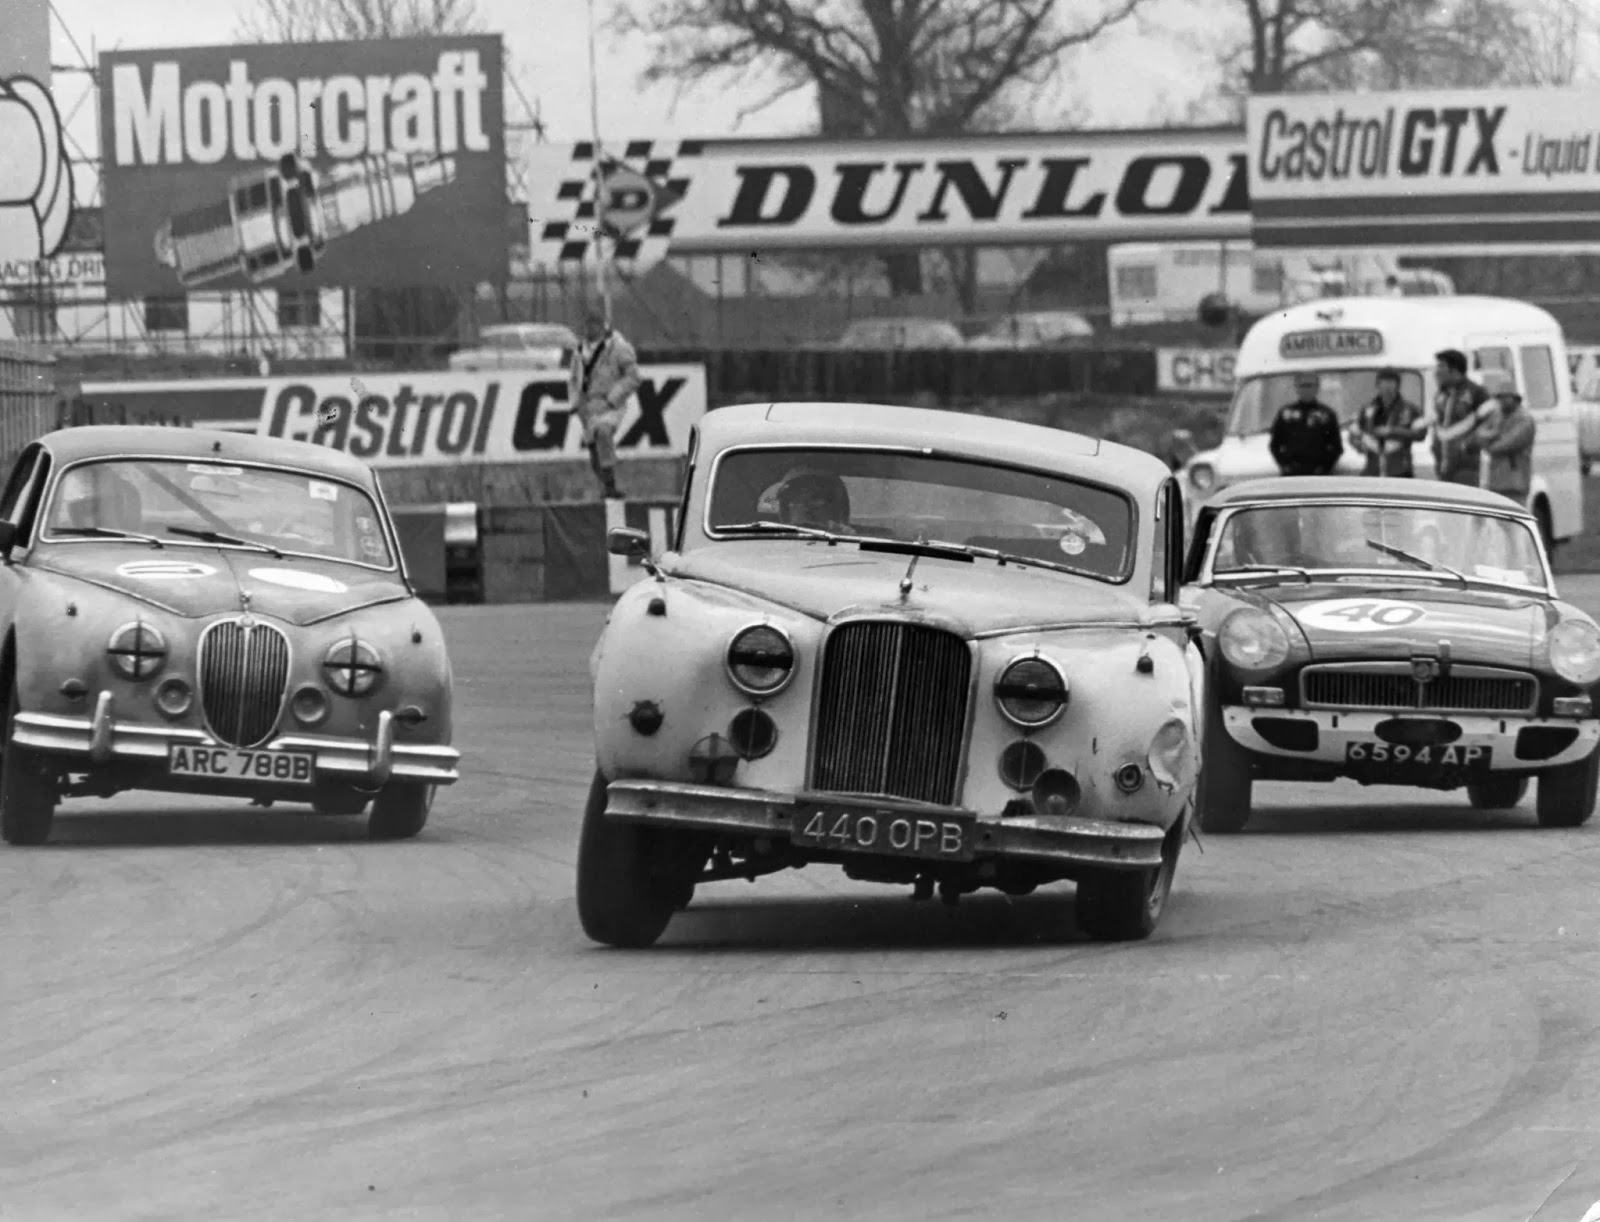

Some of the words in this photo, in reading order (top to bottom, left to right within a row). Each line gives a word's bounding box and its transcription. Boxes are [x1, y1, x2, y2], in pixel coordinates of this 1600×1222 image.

[112, 50, 490, 166] Motorcraft
[1259, 106, 1395, 180] Castrol
[1400, 105, 1508, 177] GTX
[1522, 130, 1592, 182] Liquid
[0, 259, 60, 281] ACING
[1284, 333, 1378, 353] AMBULANCE
[268, 382, 500, 457] Castrol
[513, 377, 688, 451] GX
[1321, 603, 1426, 627] 40
[173, 747, 229, 774] ARC
[236, 751, 311, 781] 788B
[1349, 742, 1432, 765] 6594
[1440, 744, 1483, 766] AP
[803, 811, 877, 846] 440
[889, 818, 963, 853] OPB
